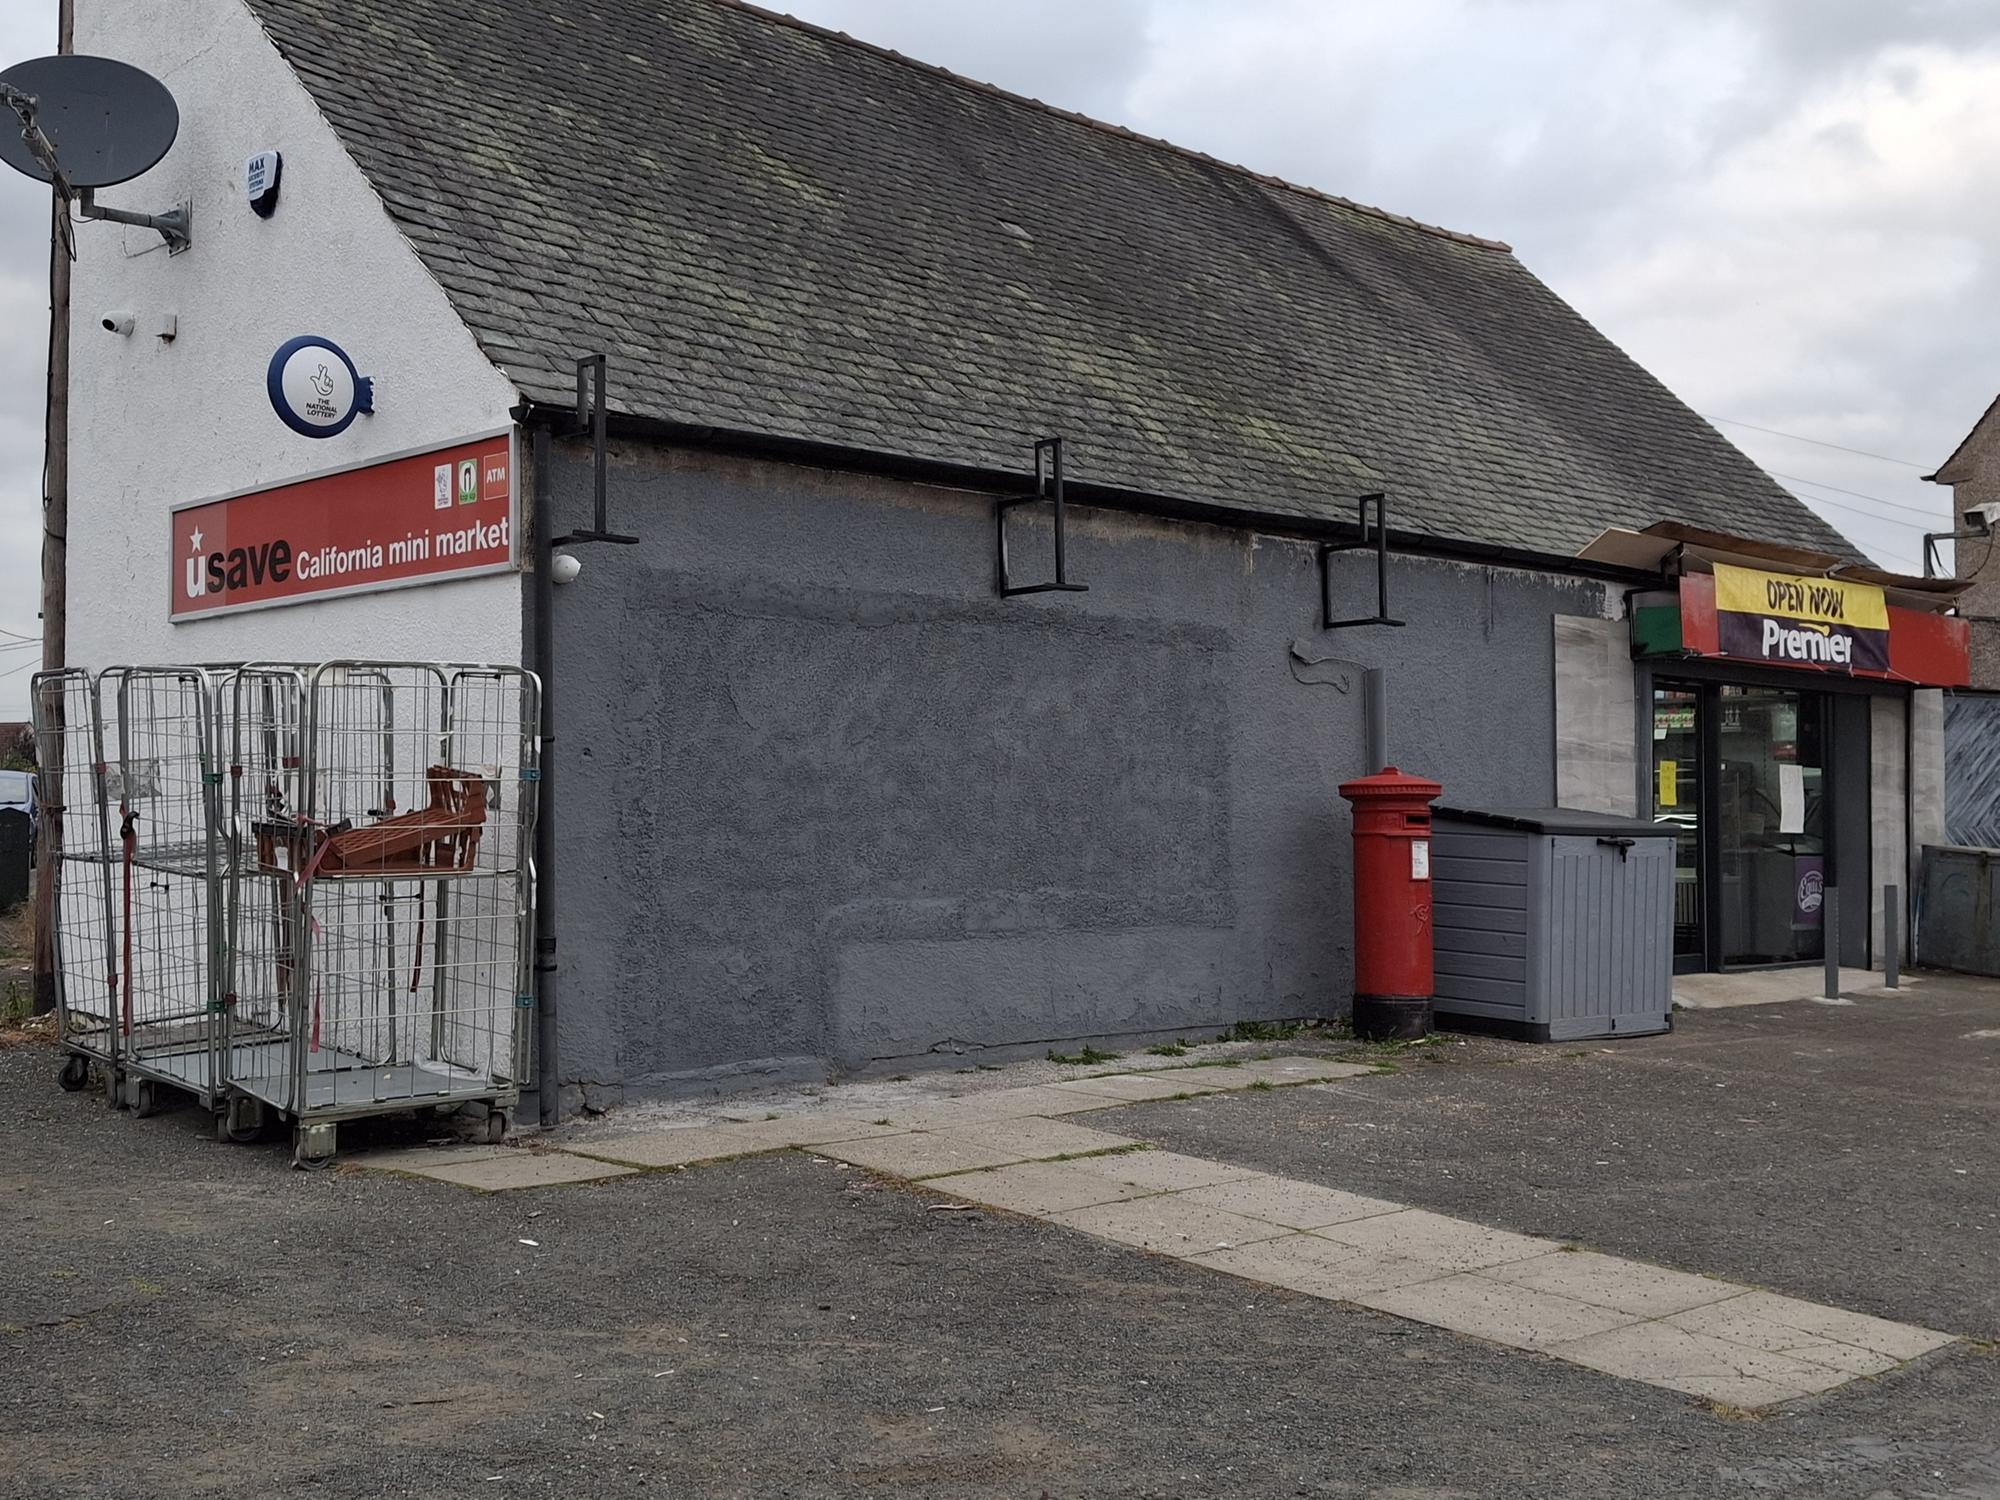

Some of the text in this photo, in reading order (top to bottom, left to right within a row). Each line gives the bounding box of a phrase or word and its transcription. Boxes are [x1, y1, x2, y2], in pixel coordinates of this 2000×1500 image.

[249, 157, 264, 175] MAX
[306, 402, 337, 413] NATIONAL
[307, 409, 335, 418] LOTTERY
[486, 467, 505, 484] ATM
[186, 516, 509, 598] usave California mini market
[1767, 579, 1844, 619] OPEN NOW
[1762, 618, 1853, 663] Premier
